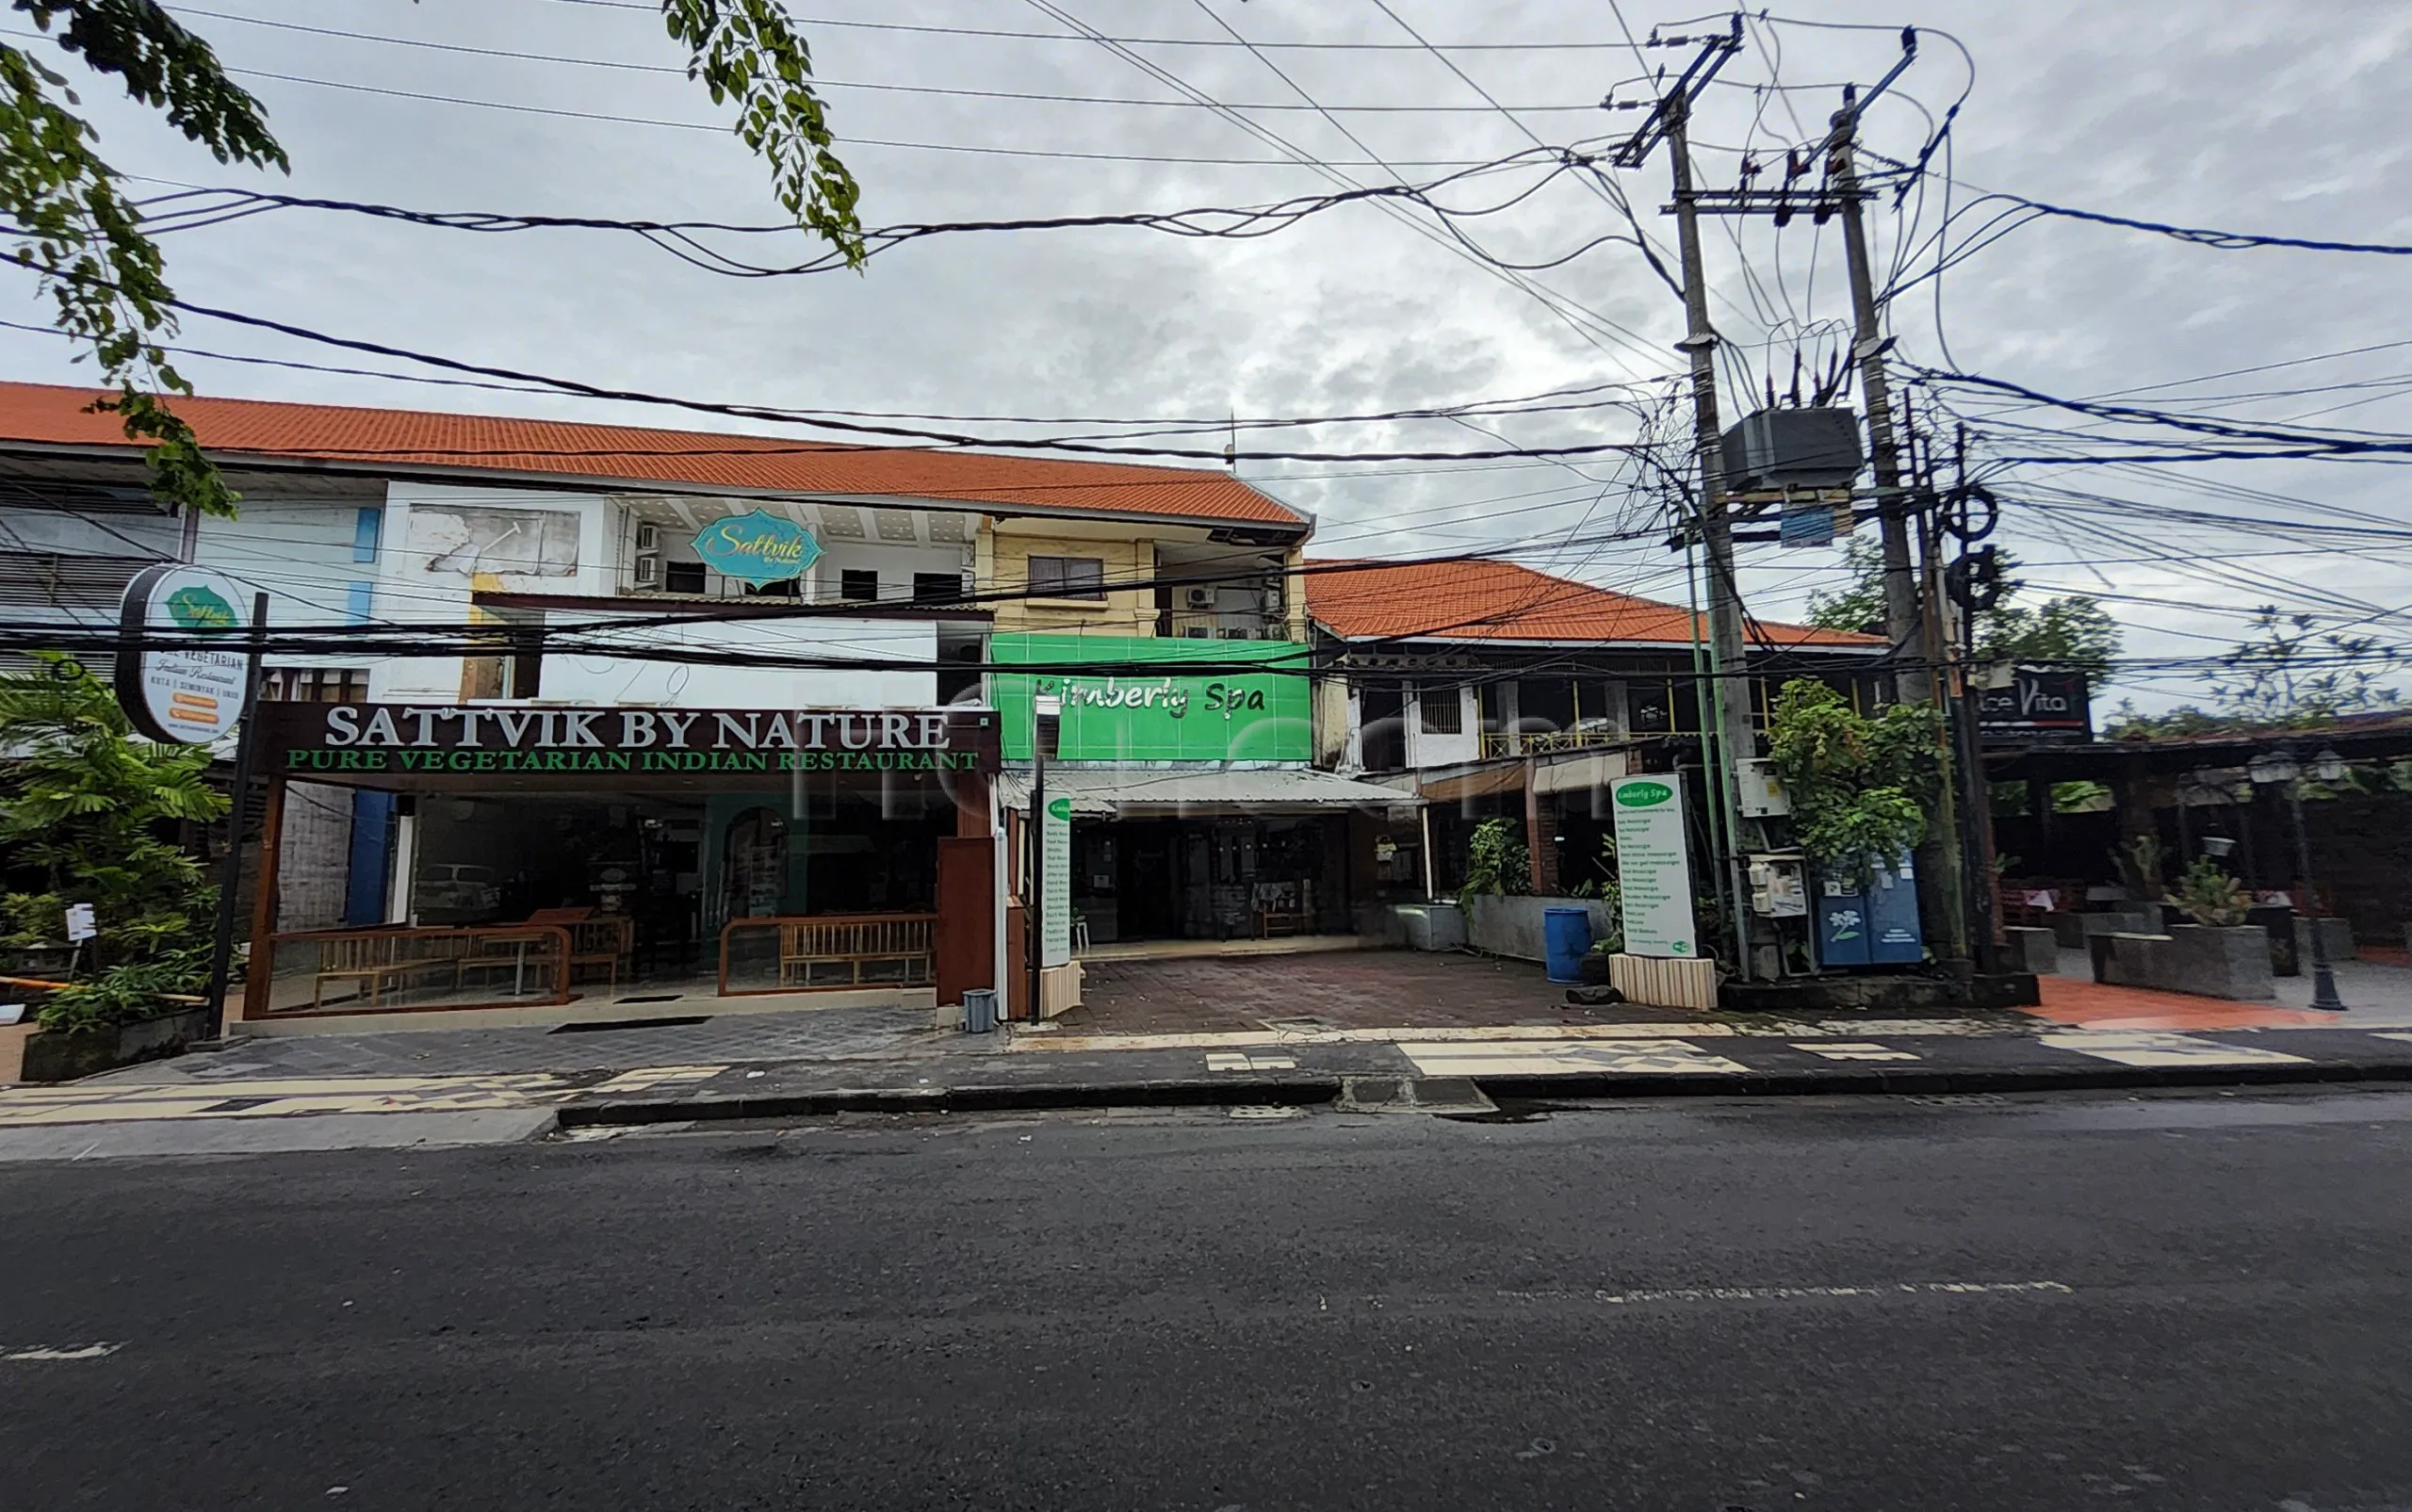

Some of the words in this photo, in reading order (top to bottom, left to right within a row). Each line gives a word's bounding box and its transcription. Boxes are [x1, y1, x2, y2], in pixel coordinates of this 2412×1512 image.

[705, 524, 802, 557] Sattvik
[1204, 682, 1265, 721] Spa
[2013, 677, 2068, 716] Vita
[325, 706, 606, 748] SATTVIK
[617, 711, 701, 749] BY
[711, 712, 950, 750] NATURE
[285, 749, 387, 771] PURE
[397, 751, 632, 772] VEGETARIAN
[642, 751, 769, 772] INDIAN
[777, 751, 978, 772] RESTAURANT
[1650, 788, 1668, 800] Spa
